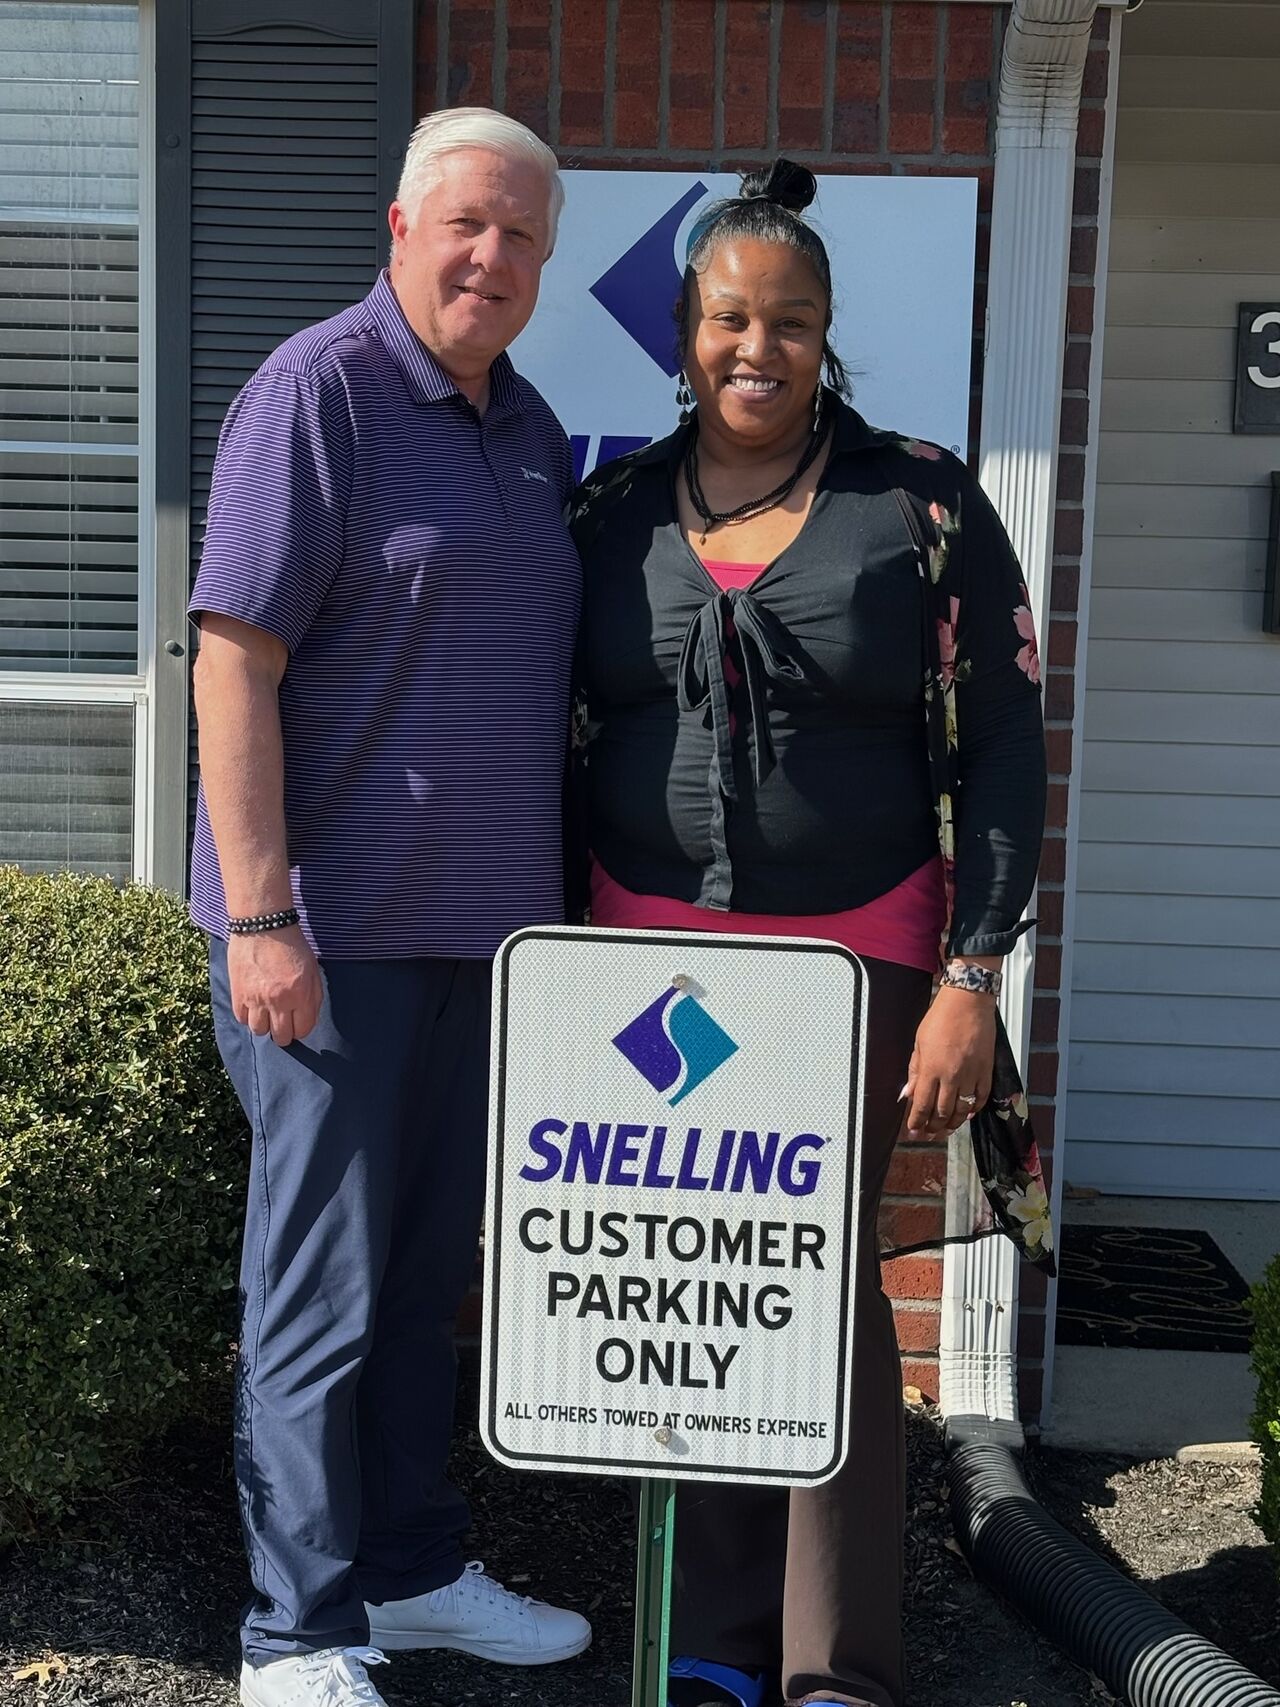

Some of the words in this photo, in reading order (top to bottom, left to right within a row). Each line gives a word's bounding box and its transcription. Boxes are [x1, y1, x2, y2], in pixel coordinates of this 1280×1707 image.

[519, 1118, 826, 1197] SNELLING
[518, 1207, 826, 1271] CUSTOMER
[547, 1271, 793, 1331] PARKING
[595, 1337, 740, 1390] ONLY
[504, 1402, 532, 1420] ALL
[538, 1404, 597, 1424] OTHERS
[603, 1408, 659, 1428] TOWED
[663, 1412, 680, 1430] AT
[684, 1414, 751, 1434] OWNERS
[757, 1418, 827, 1439] EXPENSE
